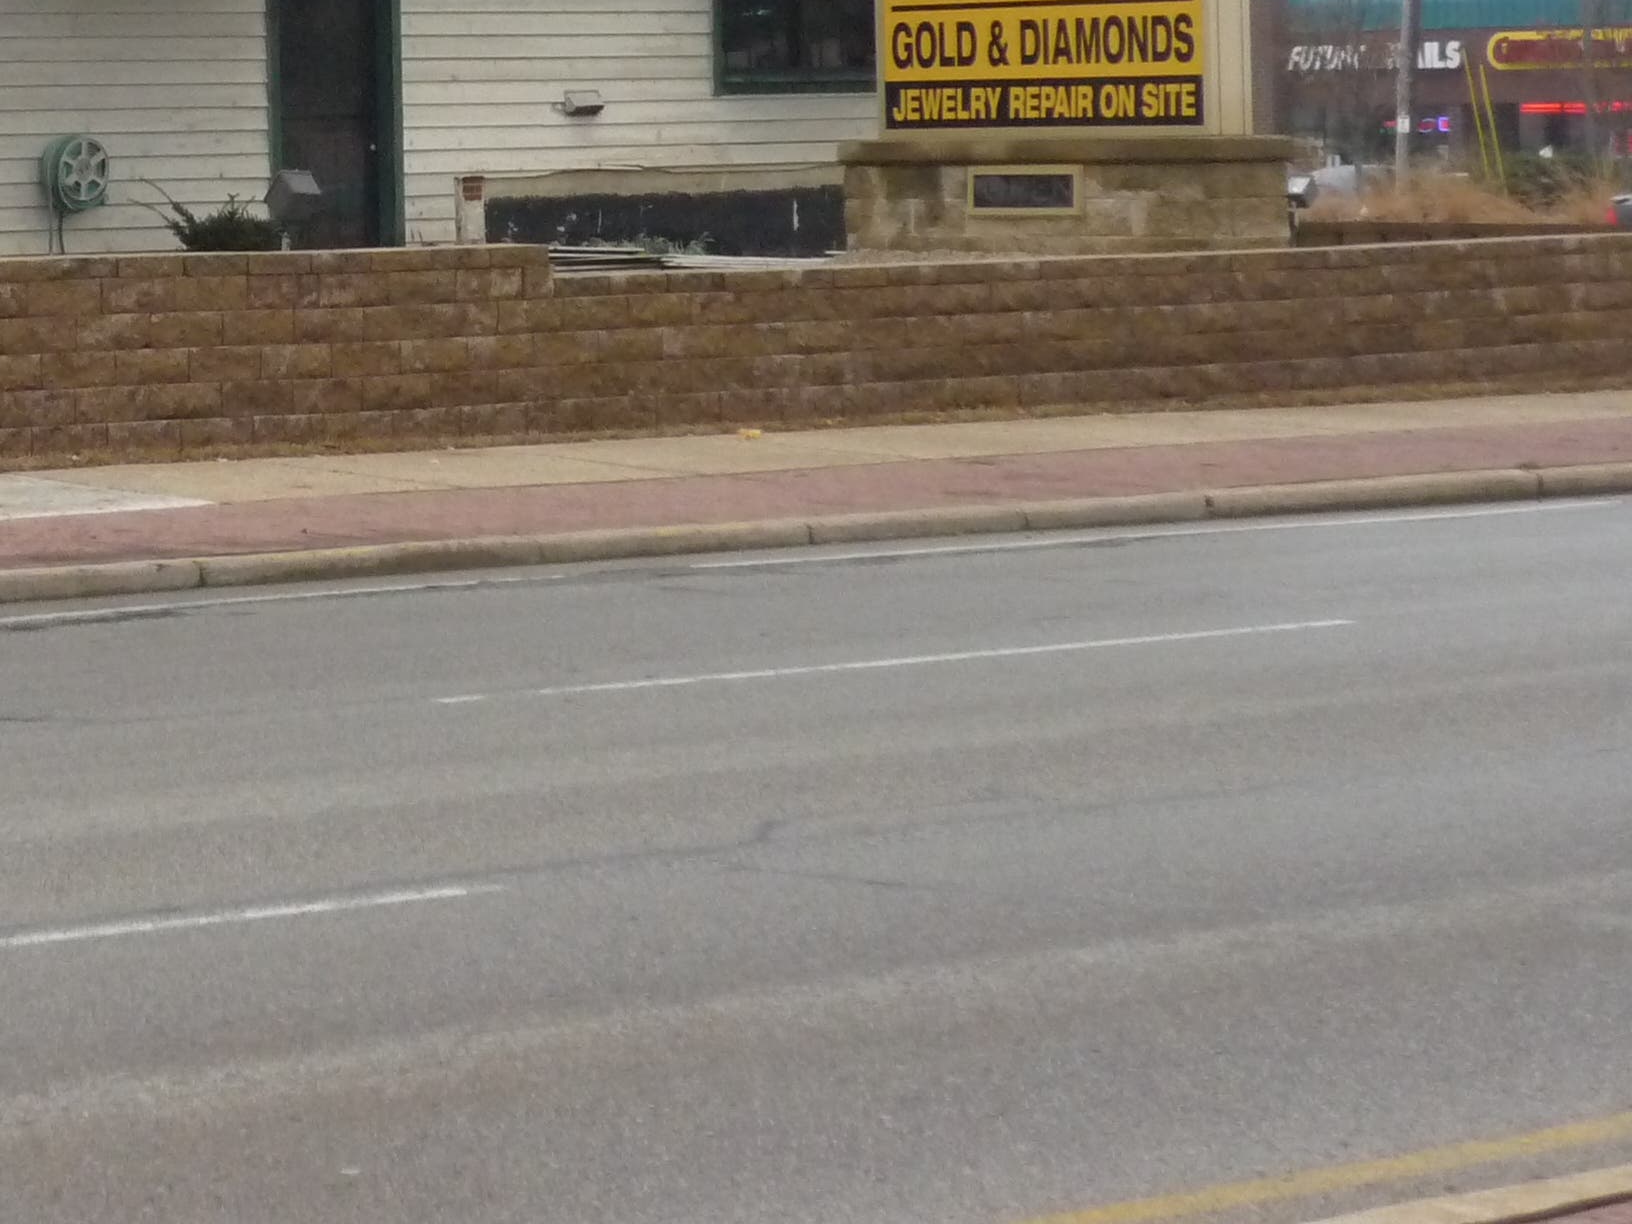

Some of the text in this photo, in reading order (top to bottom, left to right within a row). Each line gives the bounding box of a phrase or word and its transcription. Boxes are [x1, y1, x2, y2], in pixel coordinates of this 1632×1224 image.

[892, 13, 1194, 69] GOLD & DIAMONDS
[893, 83, 1197, 121] JEWELRY REPAIR ON SITE
